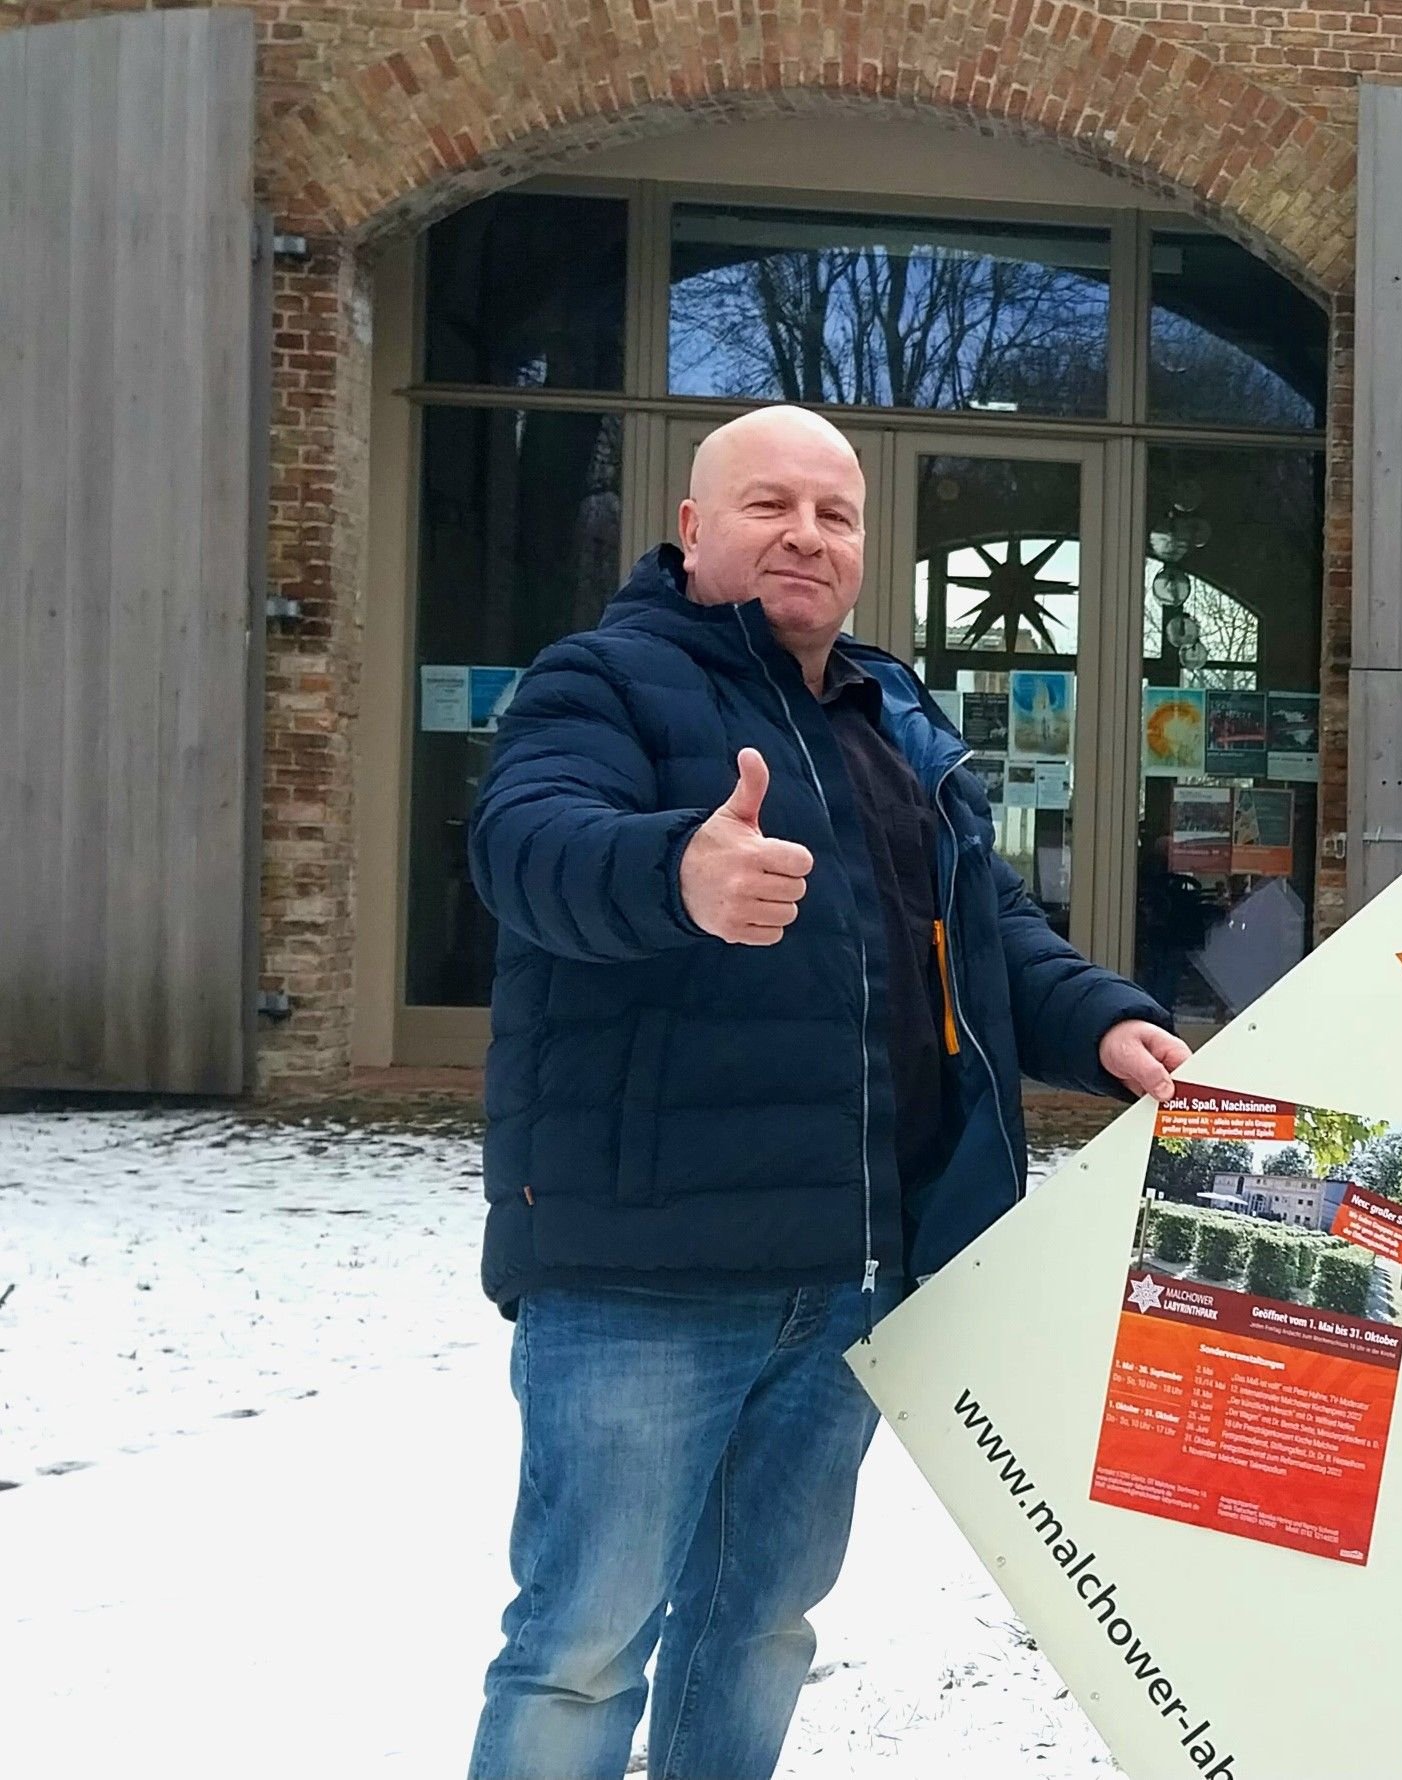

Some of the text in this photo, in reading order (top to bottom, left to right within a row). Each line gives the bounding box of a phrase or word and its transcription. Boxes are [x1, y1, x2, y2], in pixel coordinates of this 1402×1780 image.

[1163, 1097, 1277, 1113] Spiel, Spaß, Nachsinnen
[1165, 1287, 1214, 1306] MALCHOWER
[1251, 1306, 1399, 1347] Geöffnet vom 1. Mai bis 31. Oktober
